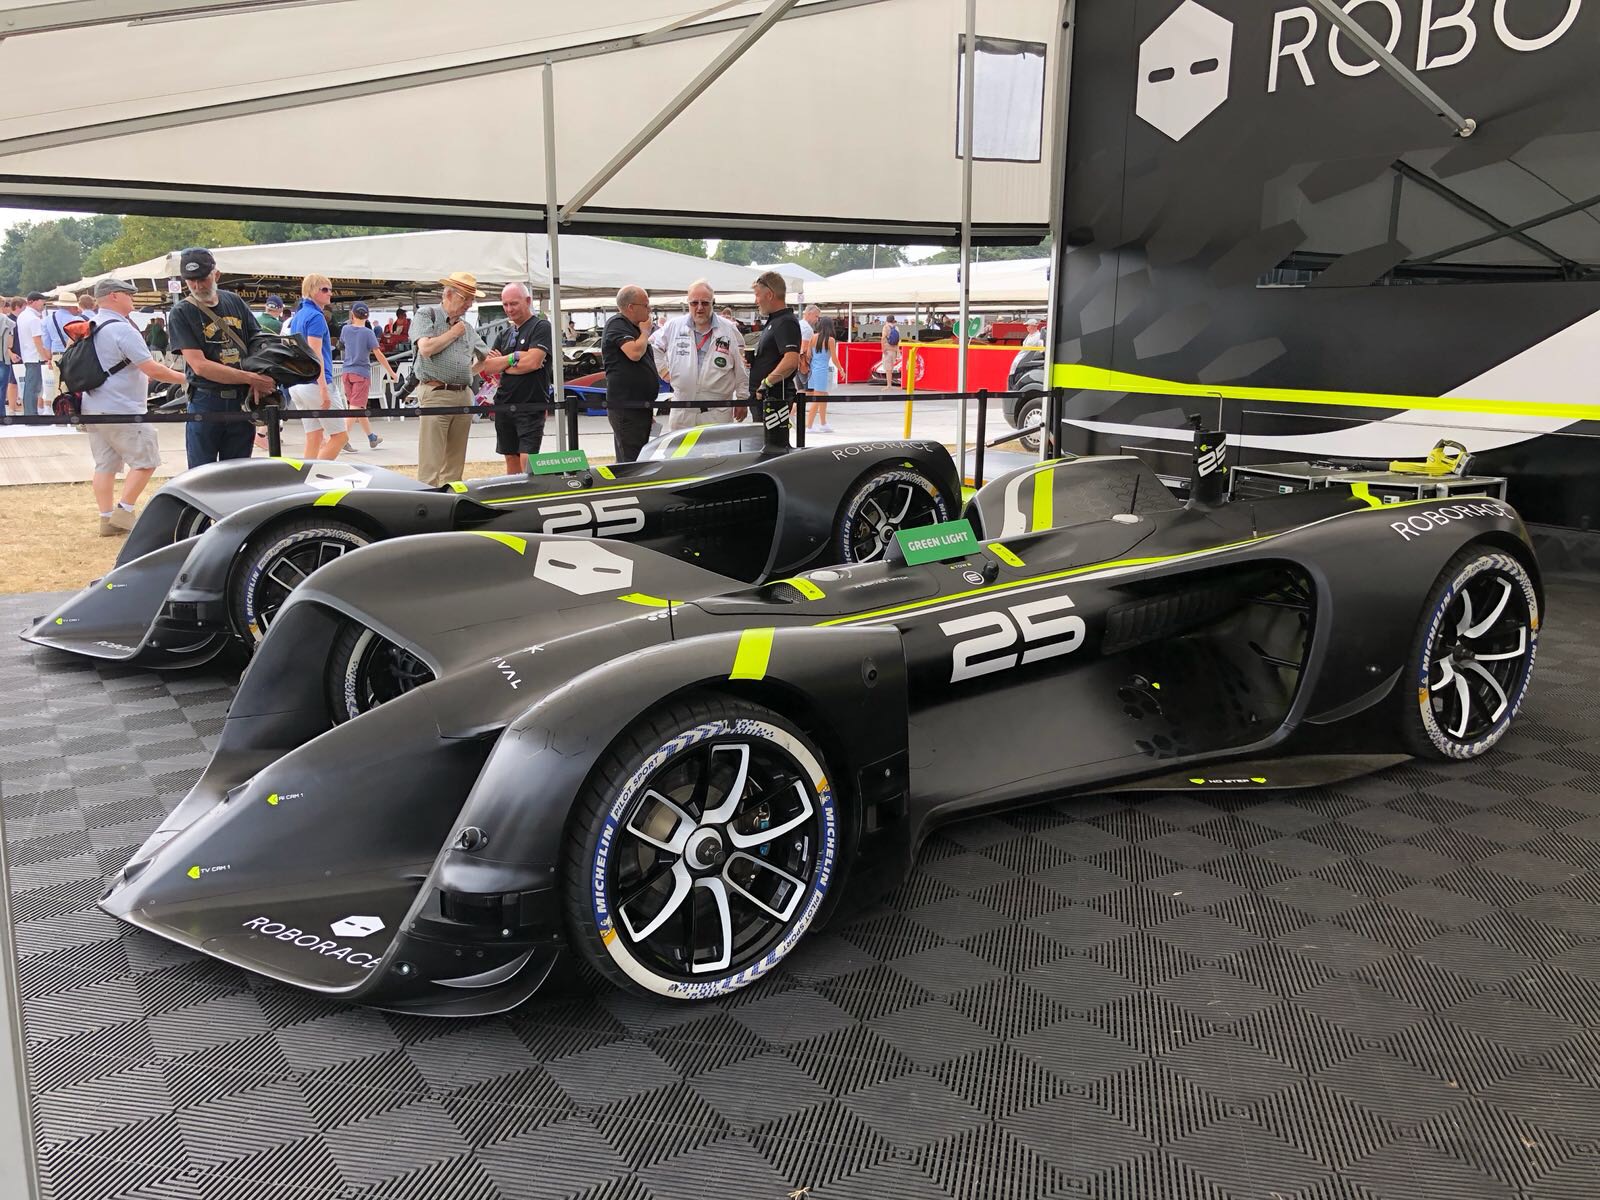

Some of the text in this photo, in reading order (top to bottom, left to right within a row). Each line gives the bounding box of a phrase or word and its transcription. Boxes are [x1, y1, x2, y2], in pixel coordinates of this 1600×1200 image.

[765, 404, 789, 430] 25
[536, 456, 582, 467] GREEN LIGHT
[831, 440, 934, 461] ROBORACE
[1197, 439, 1227, 477] 25
[537, 496, 645, 537] 25
[1390, 503, 1515, 541] ROBORACE
[908, 531, 968, 551] GREEN LIGHT
[246, 571, 259, 616] MICHELIN
[938, 594, 1086, 683] 25
[1423, 591, 1450, 672] MICHELIN
[614, 755, 659, 817] PILOT SPORT
[594, 824, 614, 914] MICHELIN
[820, 807, 836, 887] MICHELIN
[242, 916, 383, 968] ROBORACE
[783, 895, 820, 953] PILOT SPORT
